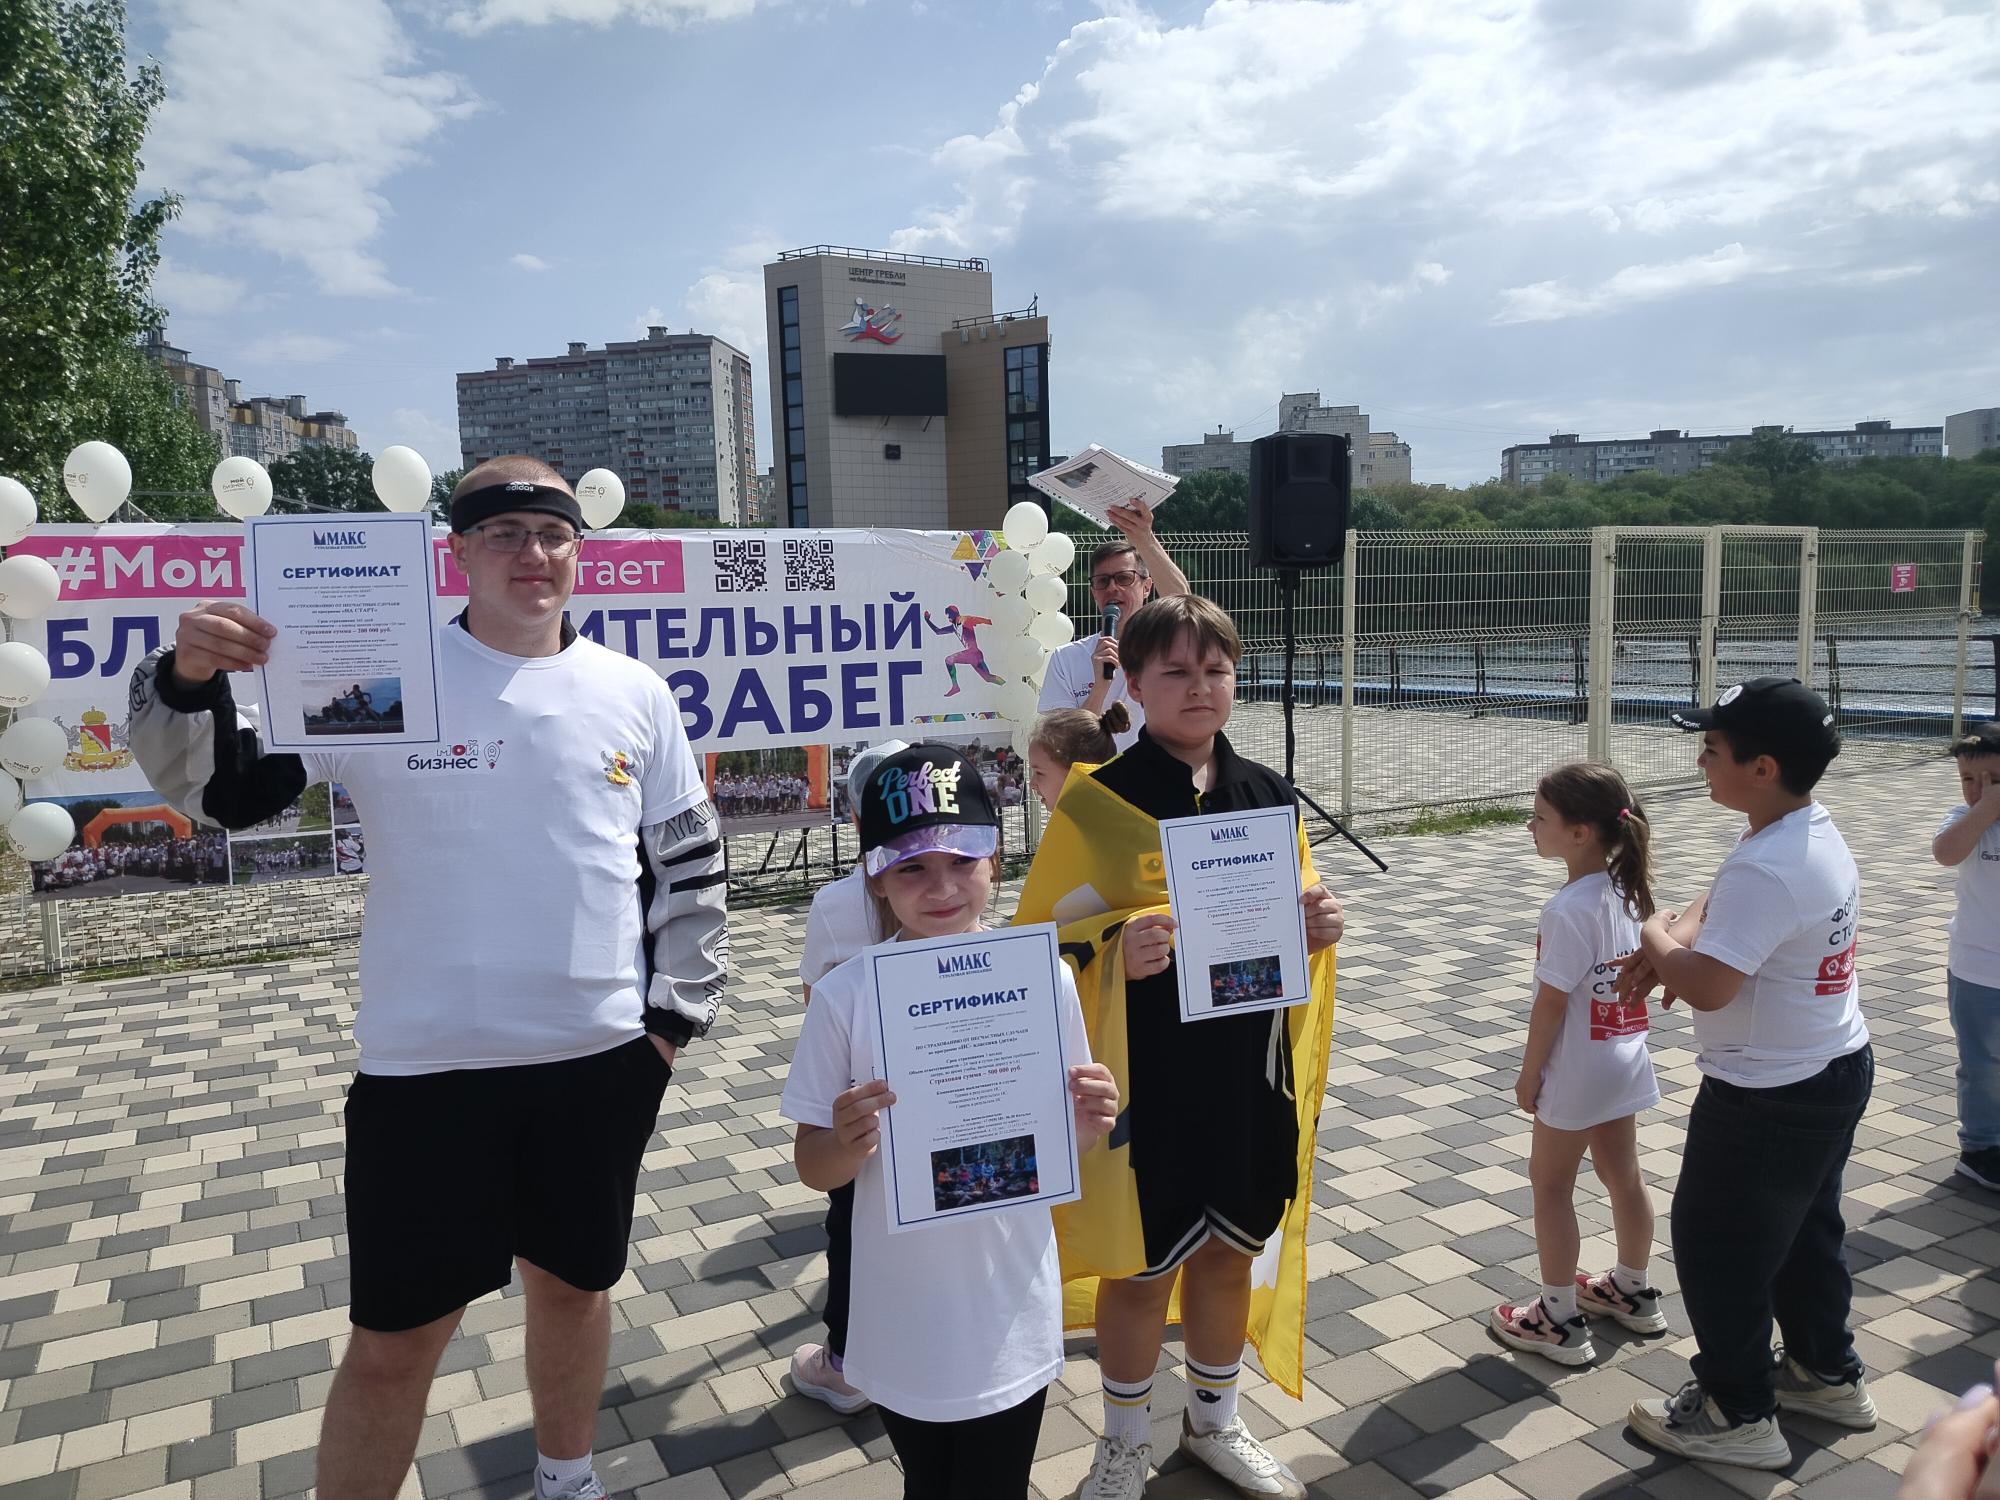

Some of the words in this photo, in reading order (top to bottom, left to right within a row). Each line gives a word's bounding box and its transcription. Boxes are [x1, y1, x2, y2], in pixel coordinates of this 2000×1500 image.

[848, 267, 873, 276] ЦЕНТР
[875, 270, 906, 280] ГРЕБЛИ
[506, 482, 533, 492] adidas
[326, 531, 367, 545] МАКС
[46, 545, 247, 591] #Мой
[283, 565, 401, 579] СЕРТИФИКАТ
[664, 660, 923, 742] ЗАБЕГ
[437, 740, 478, 756] мой
[407, 754, 478, 771] бизнес
[878, 760, 962, 801] Perfect
[886, 781, 960, 824] ONE
[1220, 826, 1249, 840] МАКС
[1192, 852, 1275, 871] СЕРТИФИКАТ
[951, 952, 992, 972] МАКС
[908, 988, 1029, 1017] СЕРТИФИКАТ
[929, 1074, 962, 1086] Страховая
[962, 1072, 982, 1081] сумма
